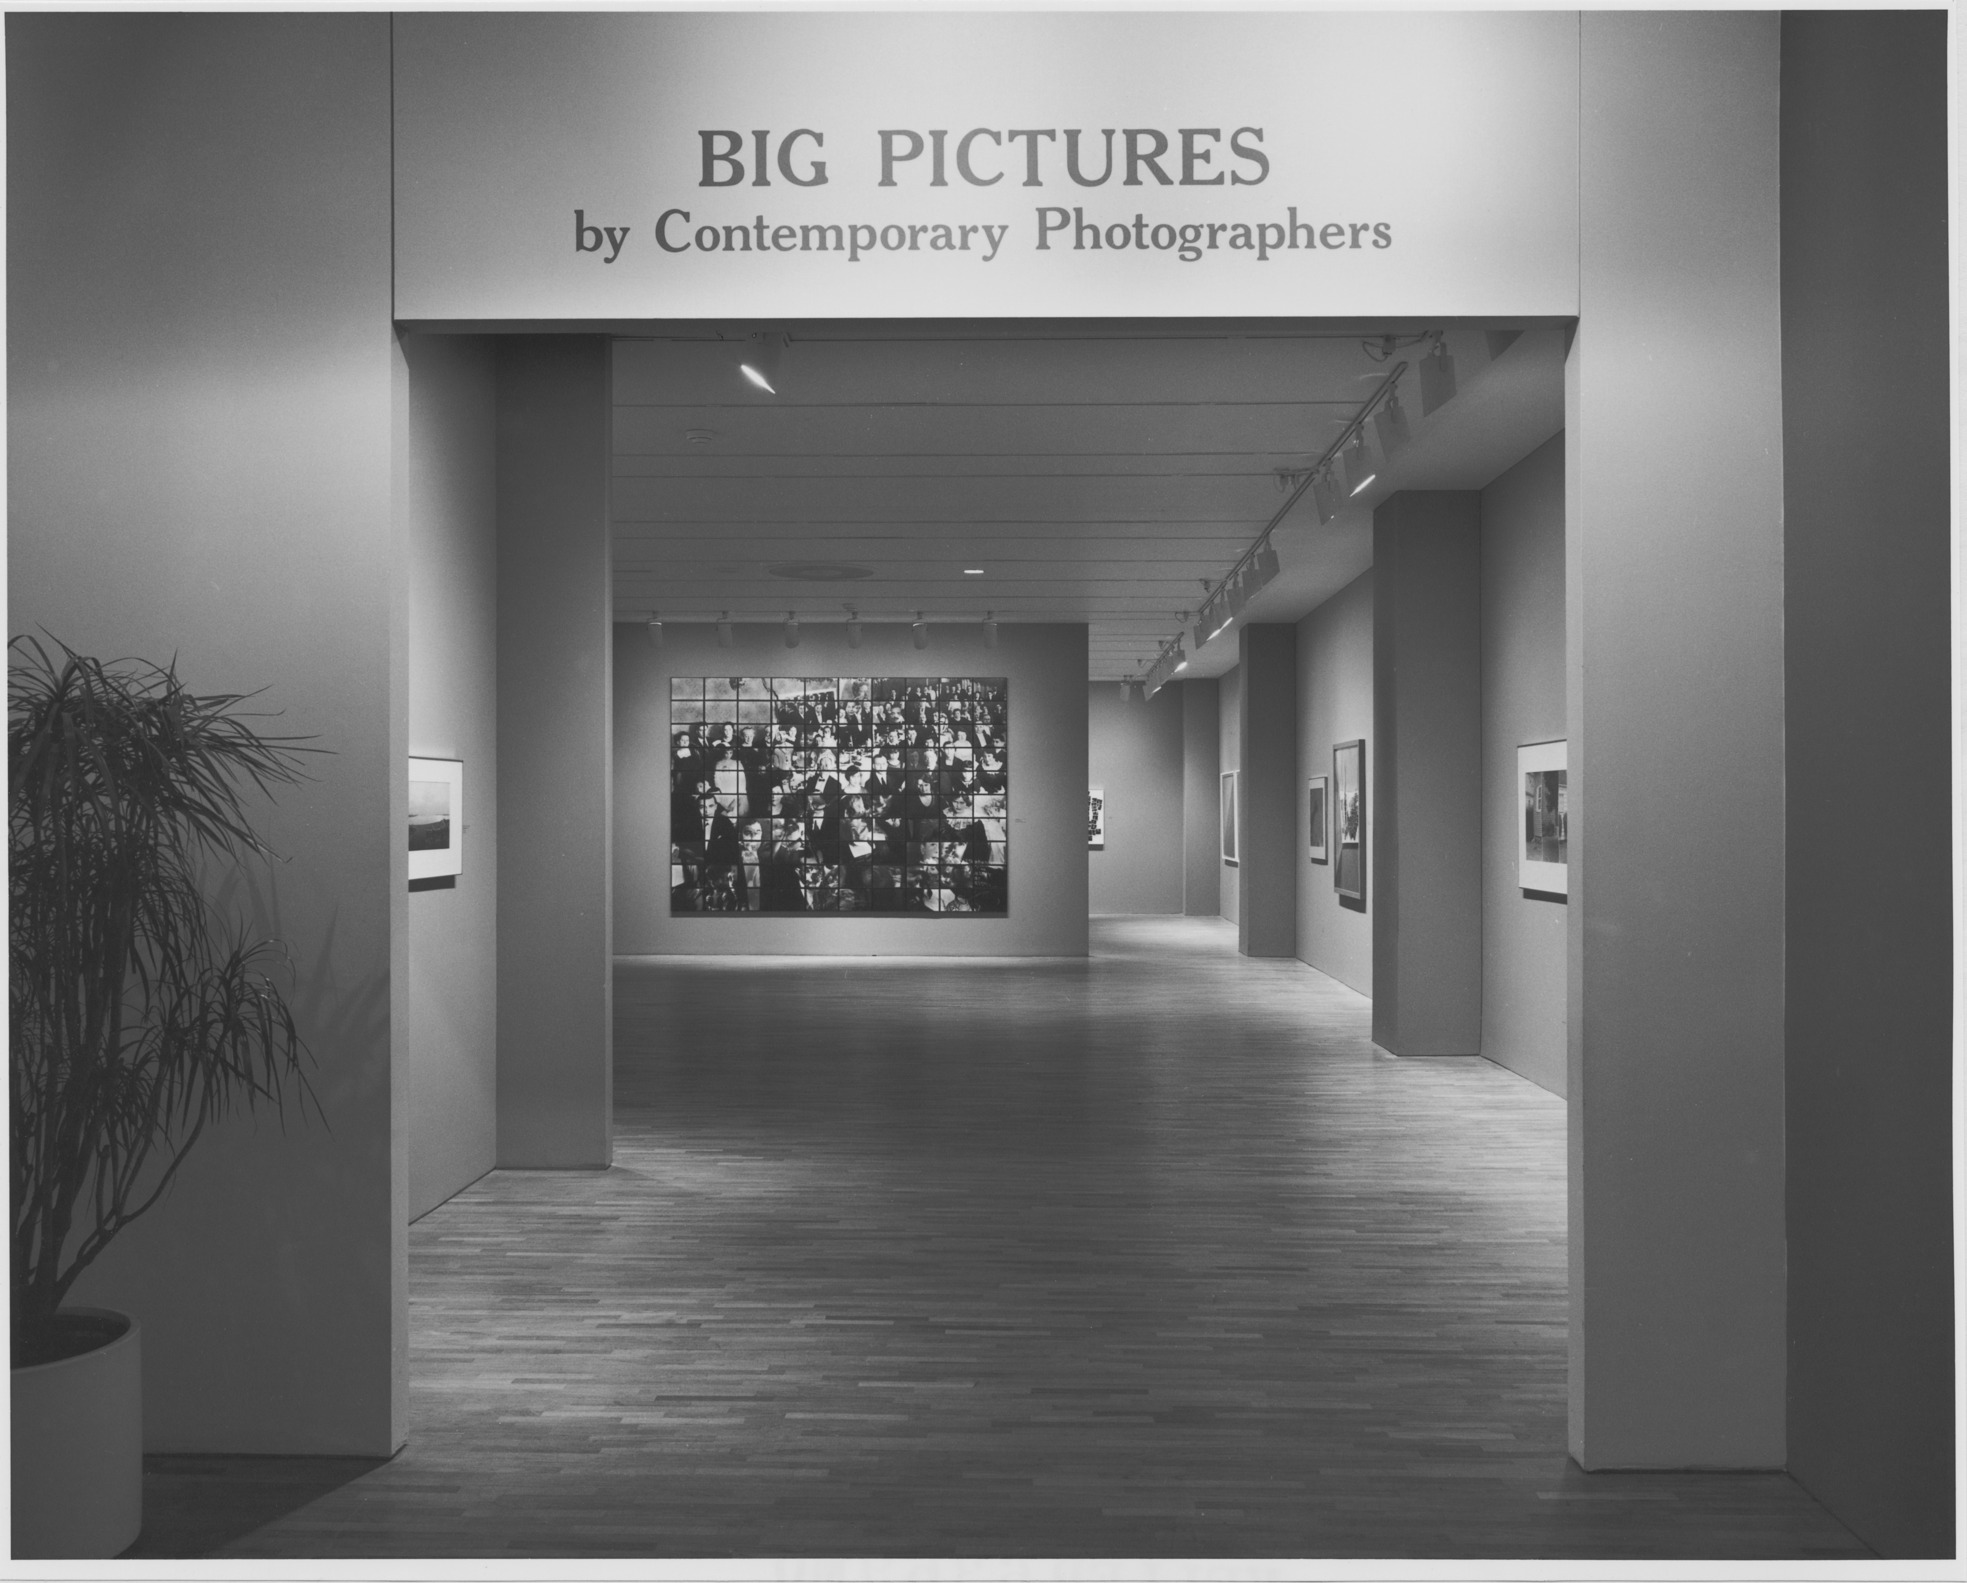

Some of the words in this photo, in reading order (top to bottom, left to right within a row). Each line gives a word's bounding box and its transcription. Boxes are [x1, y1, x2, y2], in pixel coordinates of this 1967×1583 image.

[698, 129, 828, 187] BIG
[878, 127, 1270, 188] PICTURES
[574, 210, 630, 264] by
[655, 209, 1009, 262] Contemporary
[1036, 207, 1392, 262] Photographers
